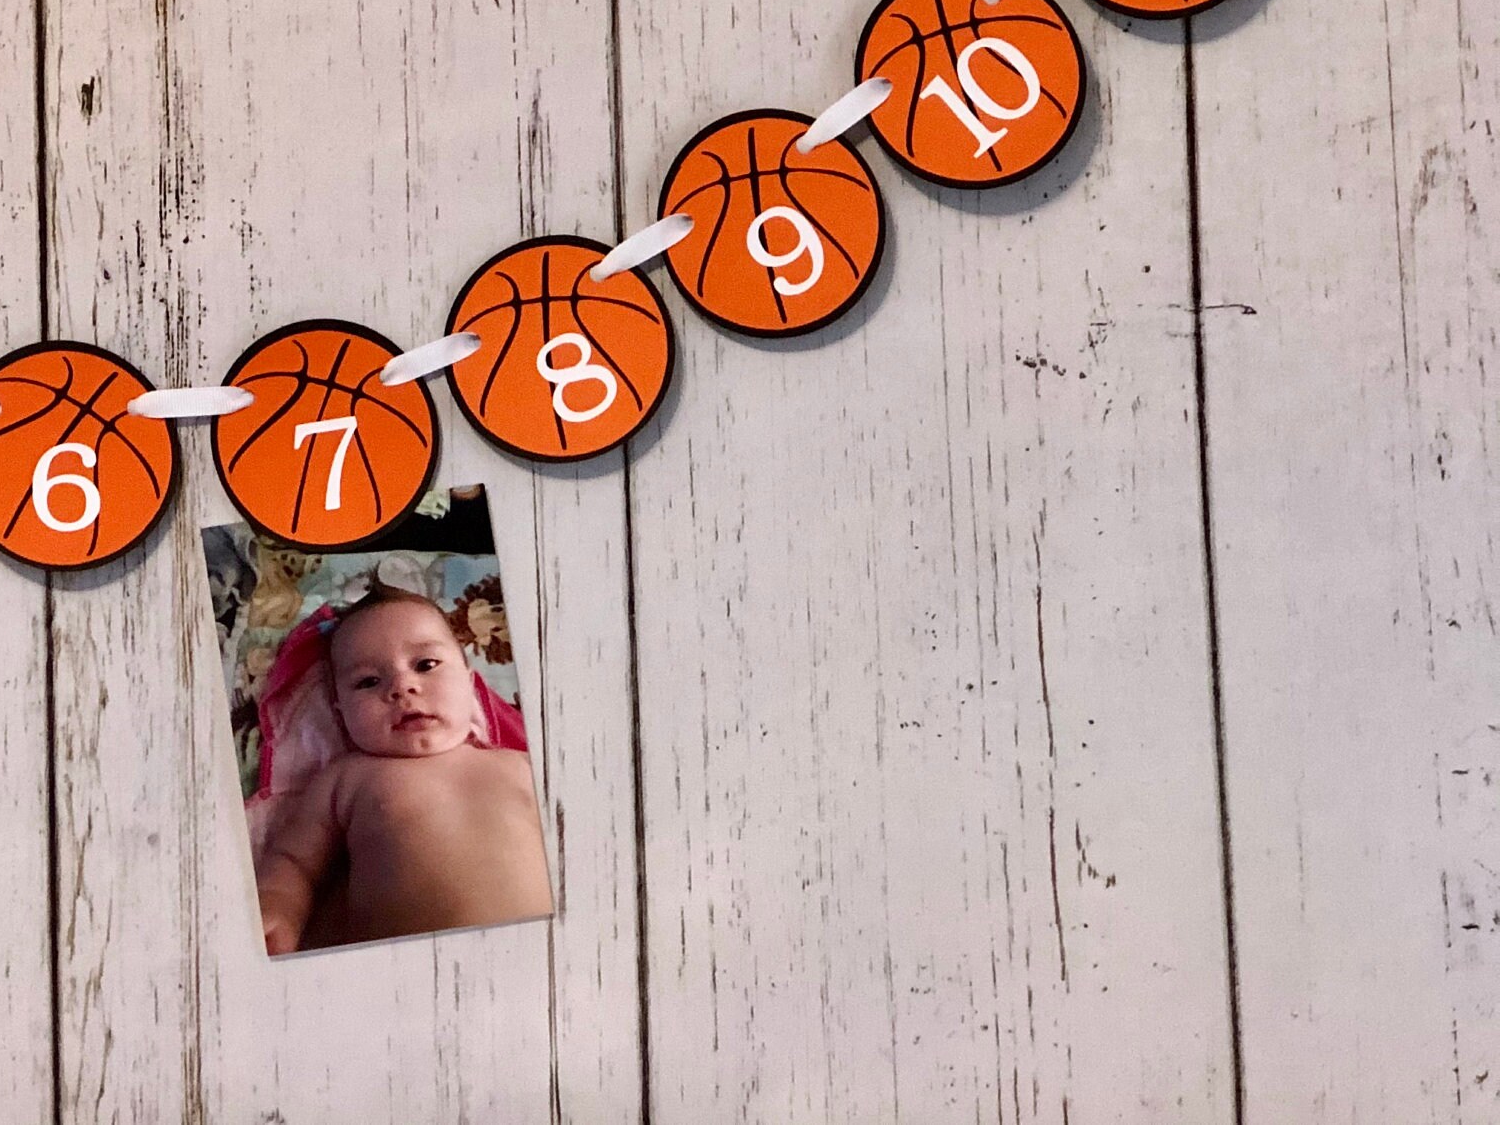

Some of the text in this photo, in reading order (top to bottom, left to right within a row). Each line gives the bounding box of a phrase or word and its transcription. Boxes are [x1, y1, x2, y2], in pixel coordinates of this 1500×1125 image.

[918, 36, 1042, 159] 10
[745, 205, 825, 297] 9
[535, 331, 619, 424] 8
[30, 441, 102, 533] 6
[293, 415, 359, 512] 7
